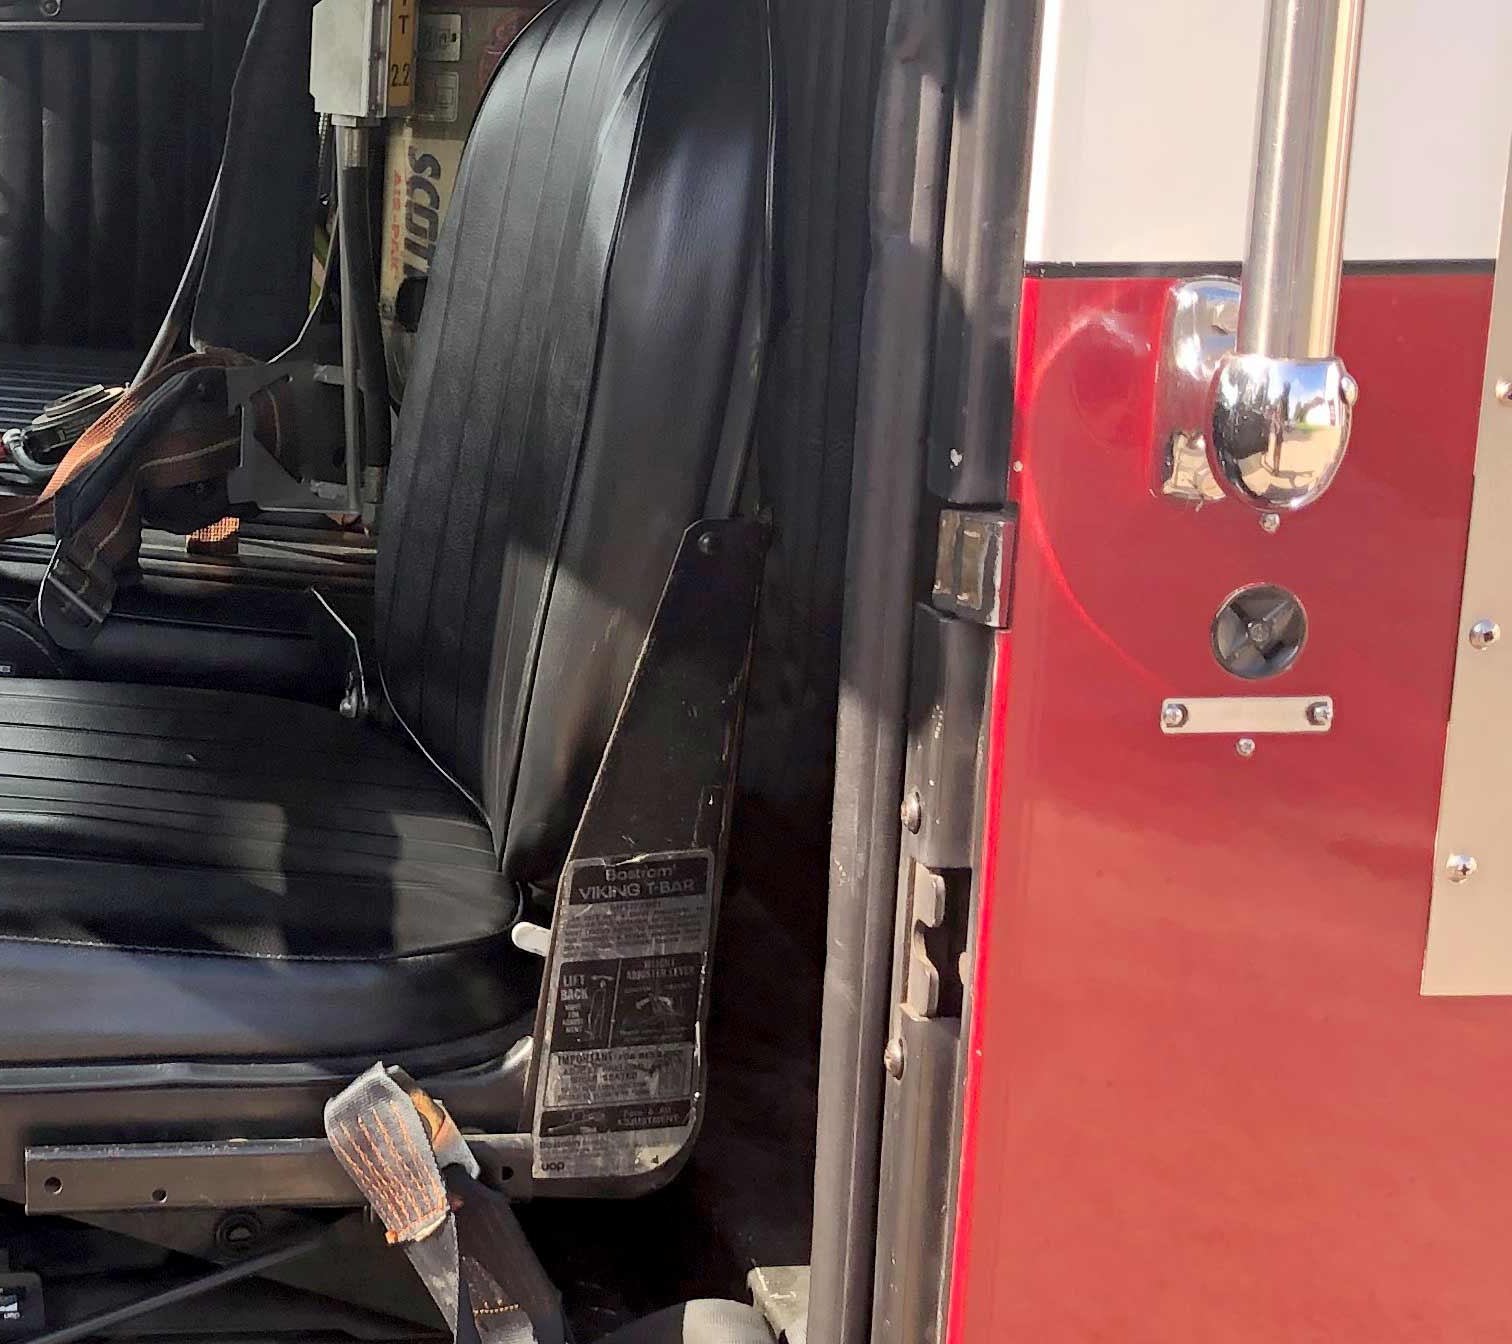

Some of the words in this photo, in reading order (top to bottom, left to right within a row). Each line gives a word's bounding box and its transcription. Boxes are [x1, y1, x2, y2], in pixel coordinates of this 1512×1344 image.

[390, 63, 410, 87] 2.2
[578, 883, 641, 900] VIKING
[647, 878, 696, 895] T-BAR
[562, 975, 586, 987] LIFT
[560, 988, 588, 1001] BACK
